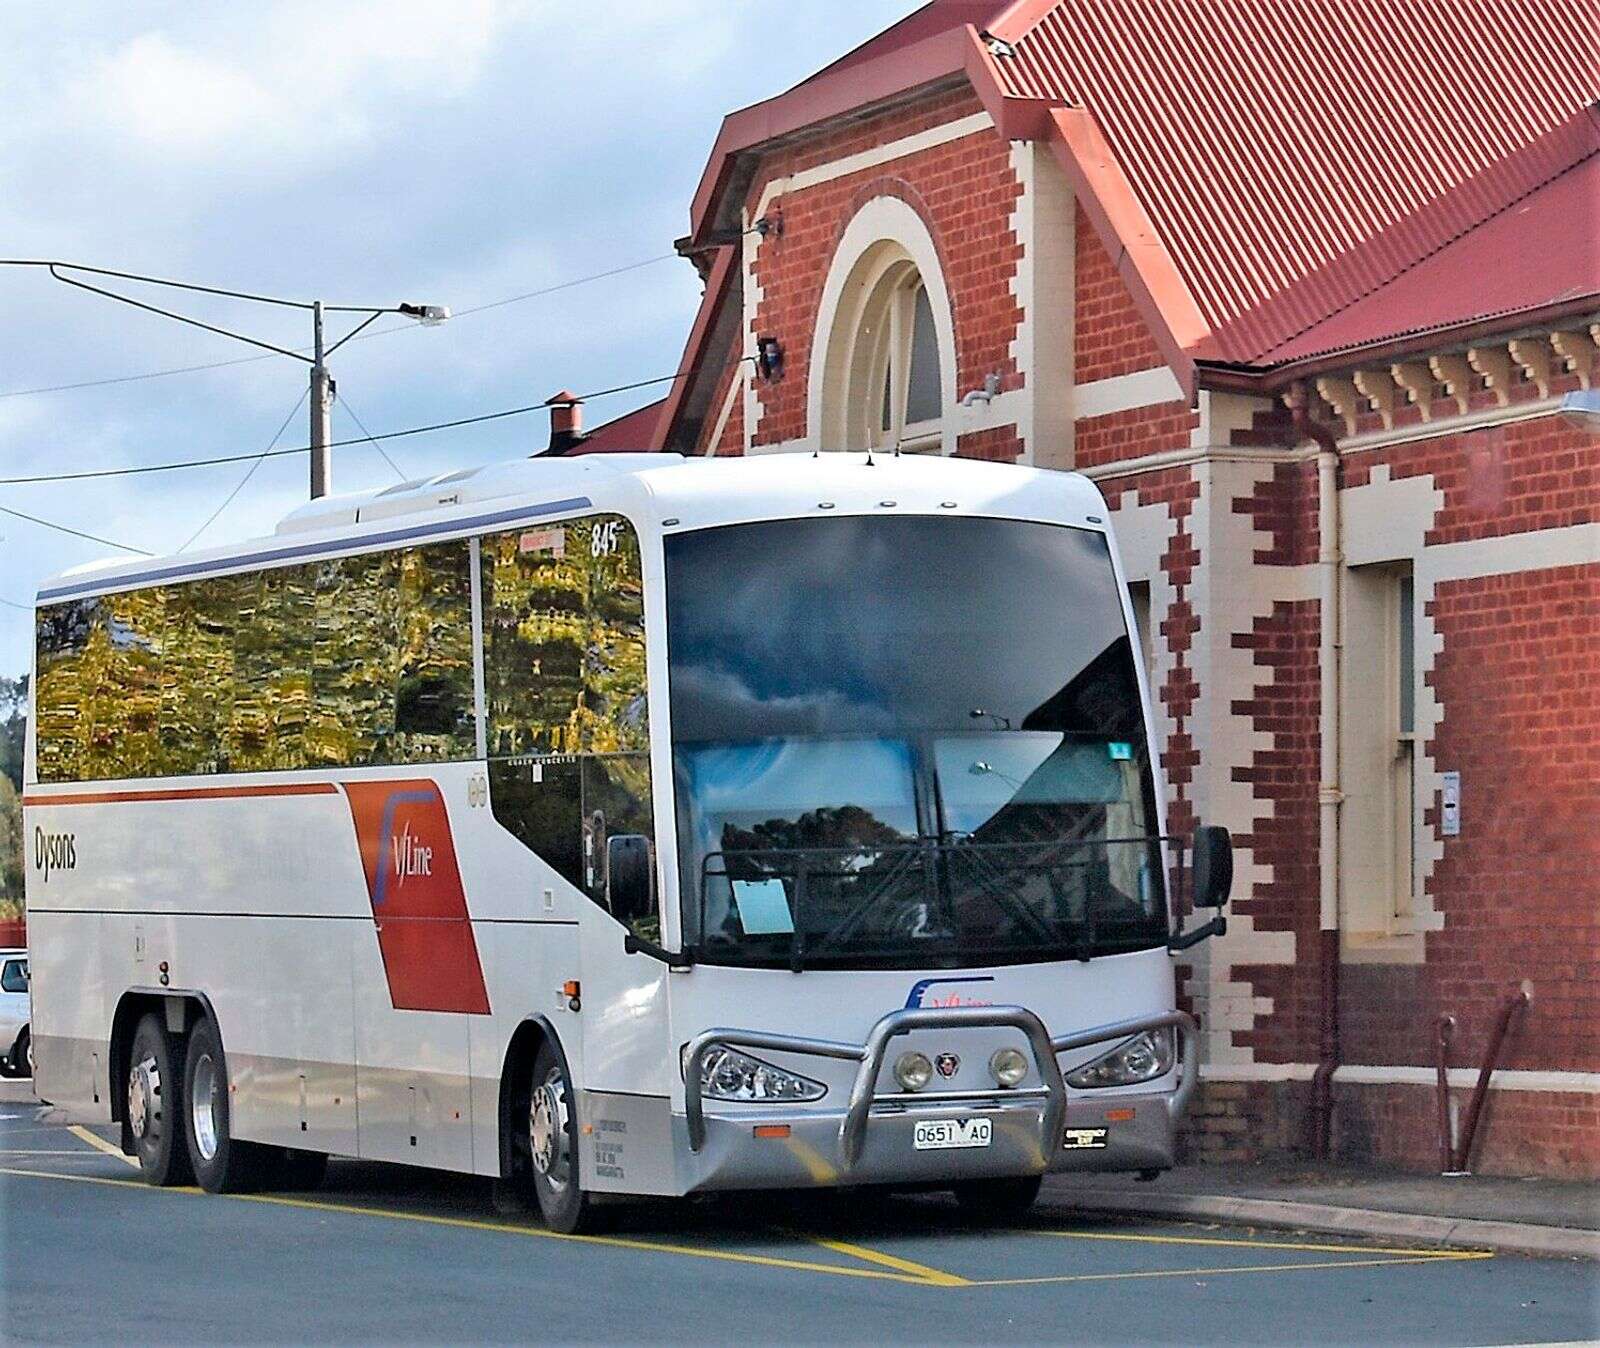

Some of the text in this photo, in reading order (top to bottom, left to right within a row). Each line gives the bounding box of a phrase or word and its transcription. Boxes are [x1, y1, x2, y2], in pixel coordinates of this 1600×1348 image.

[591, 521, 621, 557] 845
[35, 825, 76, 883] Dysons
[916, 1127, 953, 1142] 0651
